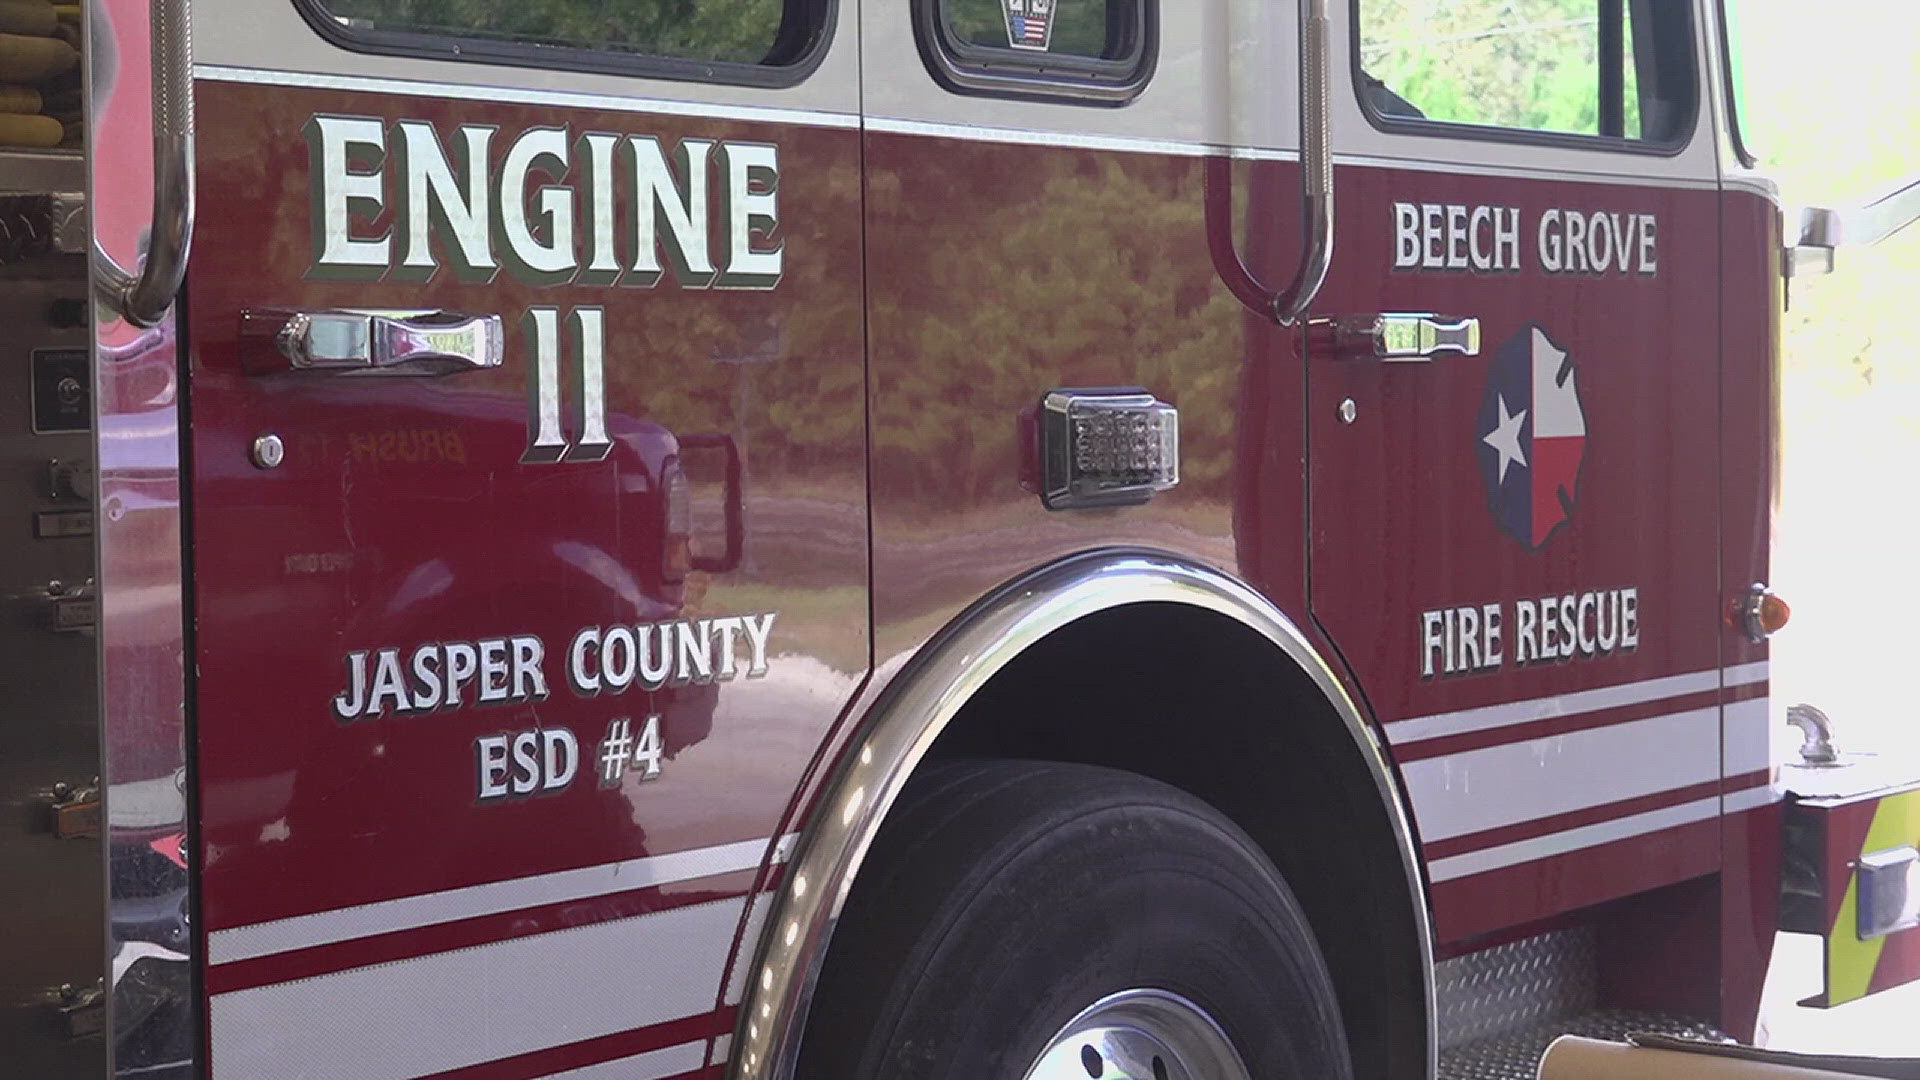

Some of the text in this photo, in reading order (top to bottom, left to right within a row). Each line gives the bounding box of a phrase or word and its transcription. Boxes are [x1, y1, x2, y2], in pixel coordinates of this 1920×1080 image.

[303, 114, 784, 289] ENGINE
[1391, 200, 1657, 277] BEECH GROVE
[334, 613, 777, 722] JASPER COUNTY
[1421, 587, 1639, 677] FIRE RESCUE
[476, 712, 663, 803] ESD #4
